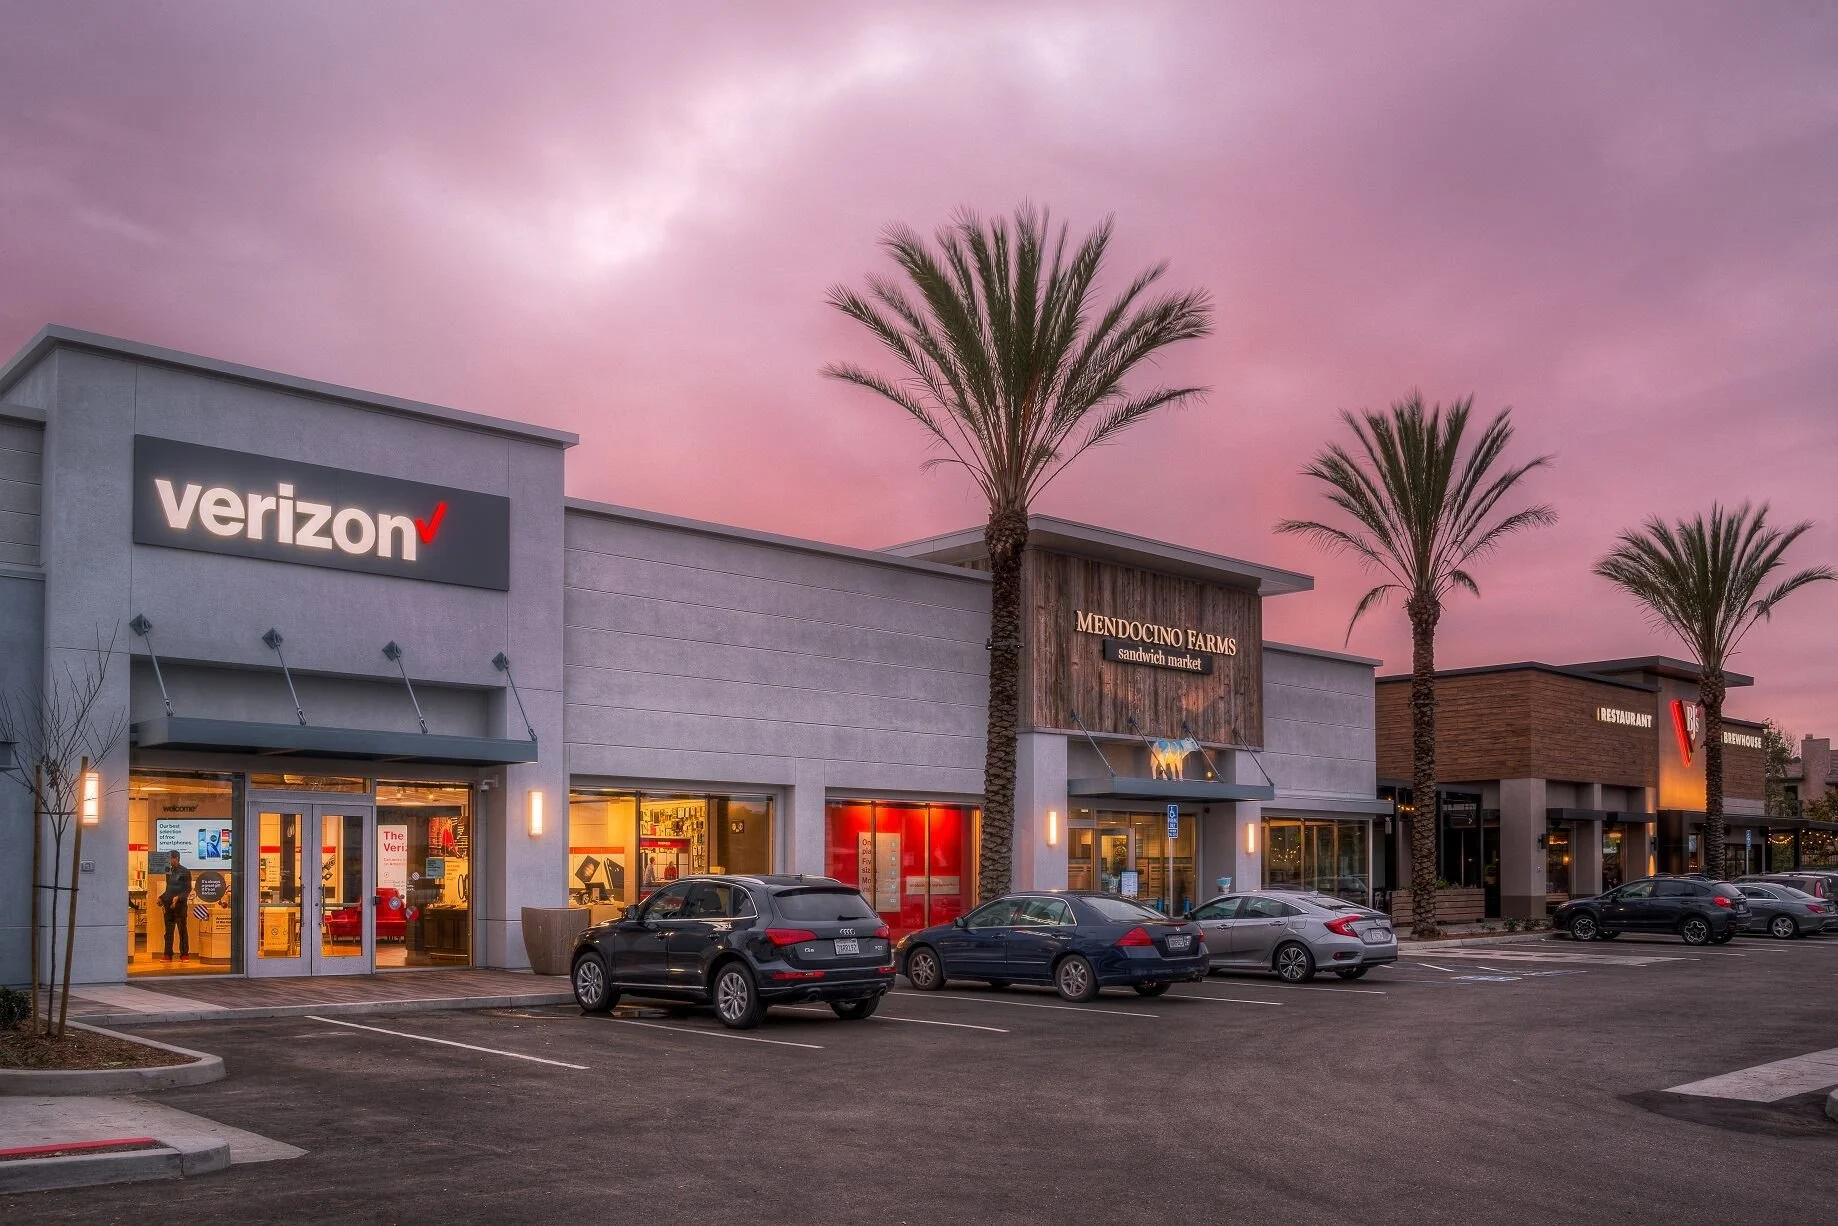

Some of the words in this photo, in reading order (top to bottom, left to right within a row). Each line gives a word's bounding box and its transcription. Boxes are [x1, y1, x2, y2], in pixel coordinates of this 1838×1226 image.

[155, 479, 416, 561] verizon
[1076, 610, 1183, 647] MENDOCINO
[1186, 629, 1236, 656] FARMS
[1118, 647, 1166, 666] sandwich
[1167, 654, 1202, 671] market
[1600, 707, 1653, 728] RESTAURANT
[1723, 731, 1762, 749] BREWHOUSE
[162, 804, 196, 813] welcome
[383, 831, 404, 841] The
